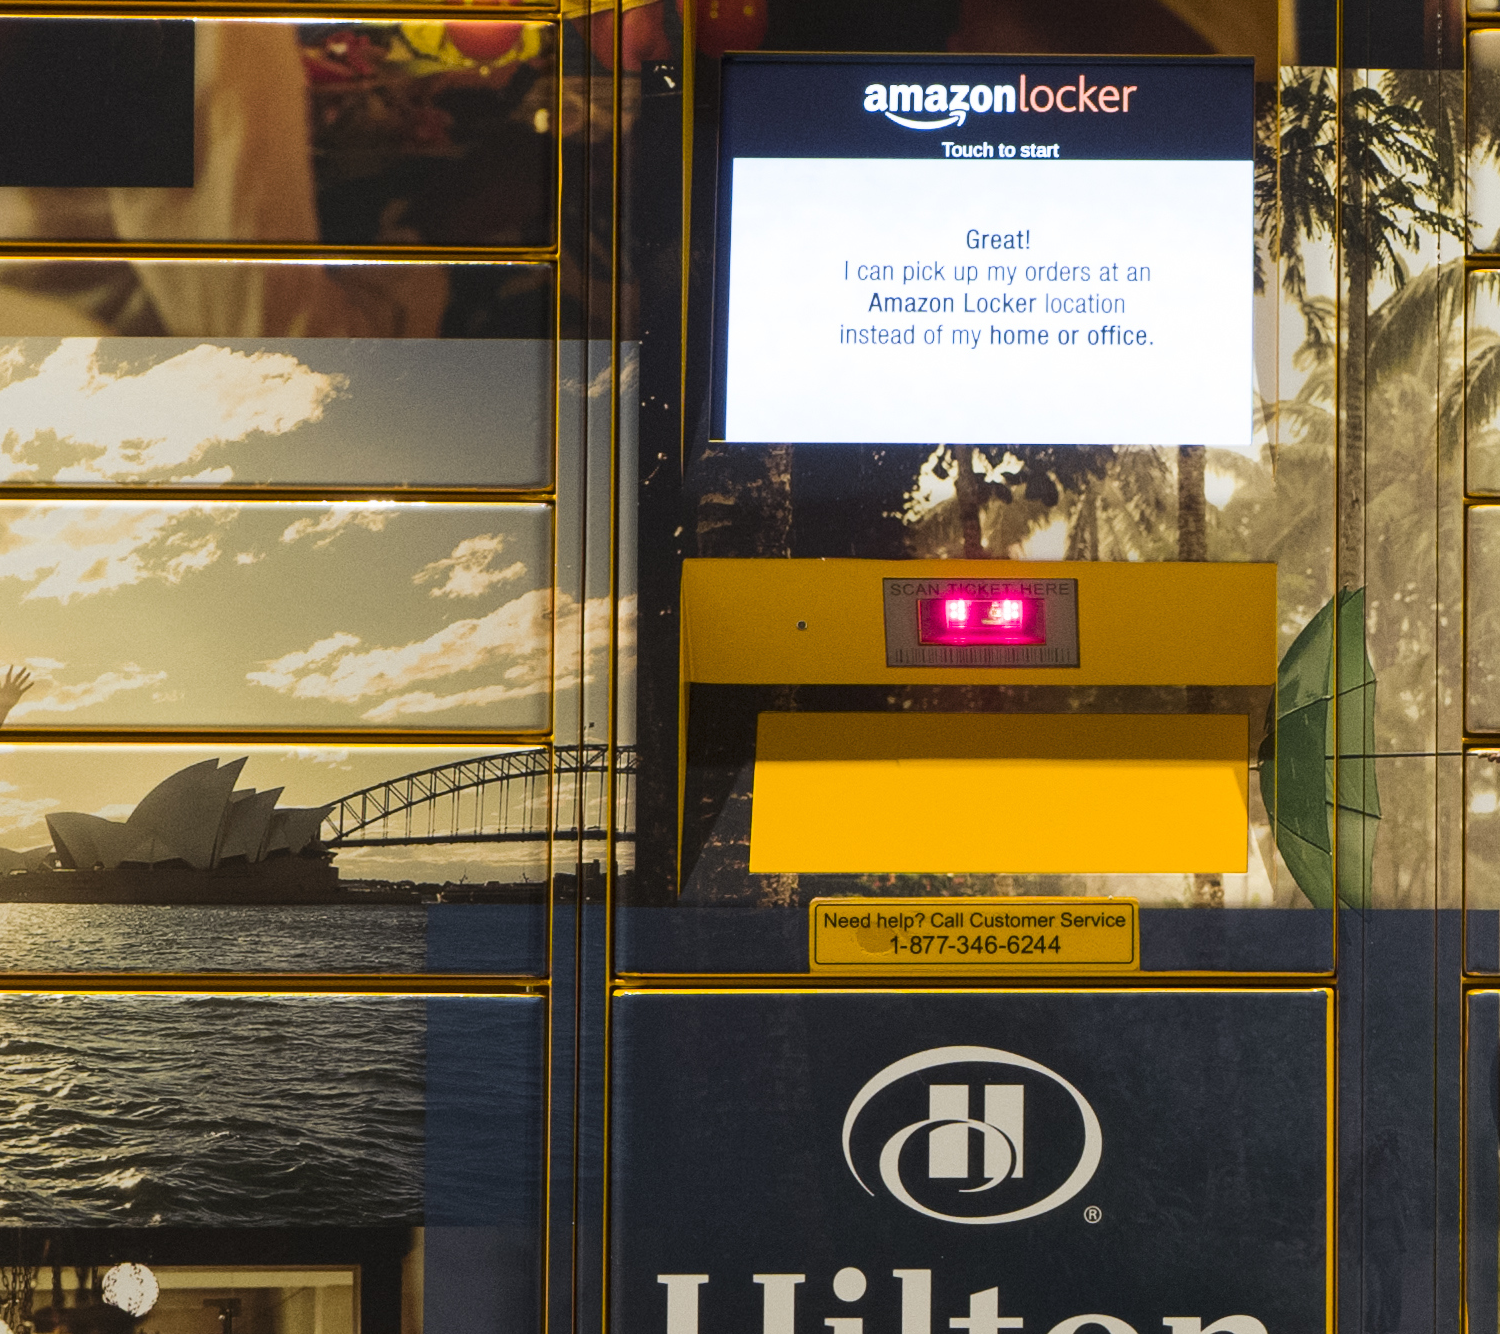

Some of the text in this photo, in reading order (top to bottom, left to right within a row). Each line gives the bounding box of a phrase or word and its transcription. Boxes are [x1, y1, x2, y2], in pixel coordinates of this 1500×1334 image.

[941, 141, 1060, 159] Touch to start
[966, 229, 1030, 249] Great!
[844, 260, 1151, 286] I can pick up my orders at an
[868, 292, 1126, 314] Amazon Locker location
[840, 324, 1154, 349] instead of my home or office.
[889, 582, 1070, 597] SCAN TICKET HERE
[823, 911, 1126, 931] Need help? Call Customer Service
[890, 935, 1062, 955] 1-877-346-6244
